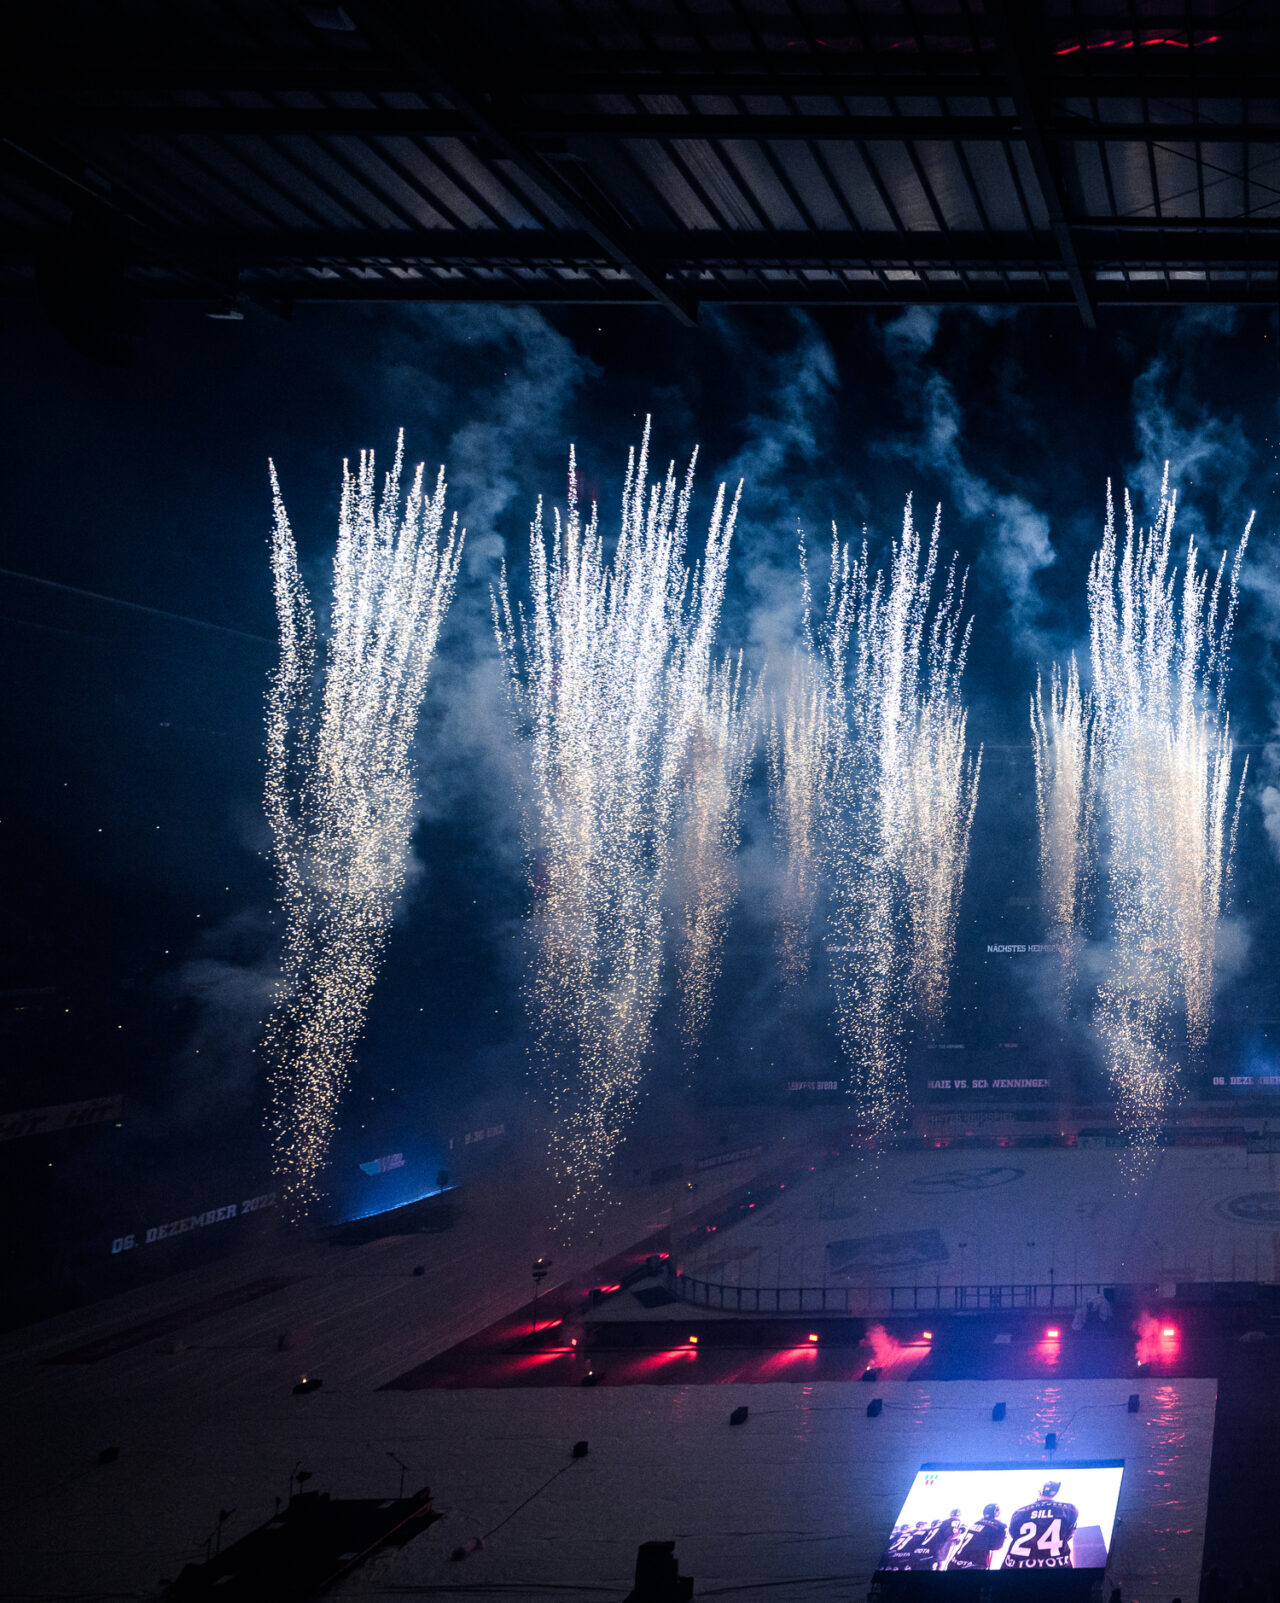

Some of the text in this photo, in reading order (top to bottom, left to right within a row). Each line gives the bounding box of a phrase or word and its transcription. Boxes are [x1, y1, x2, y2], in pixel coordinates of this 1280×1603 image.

[987, 942, 1026, 952] NÄCHSTES
[111, 1192, 277, 1254] 06. DEZEMBER 2022
[1030, 1509, 1054, 1519] SILL
[1010, 1519, 1063, 1557] 24
